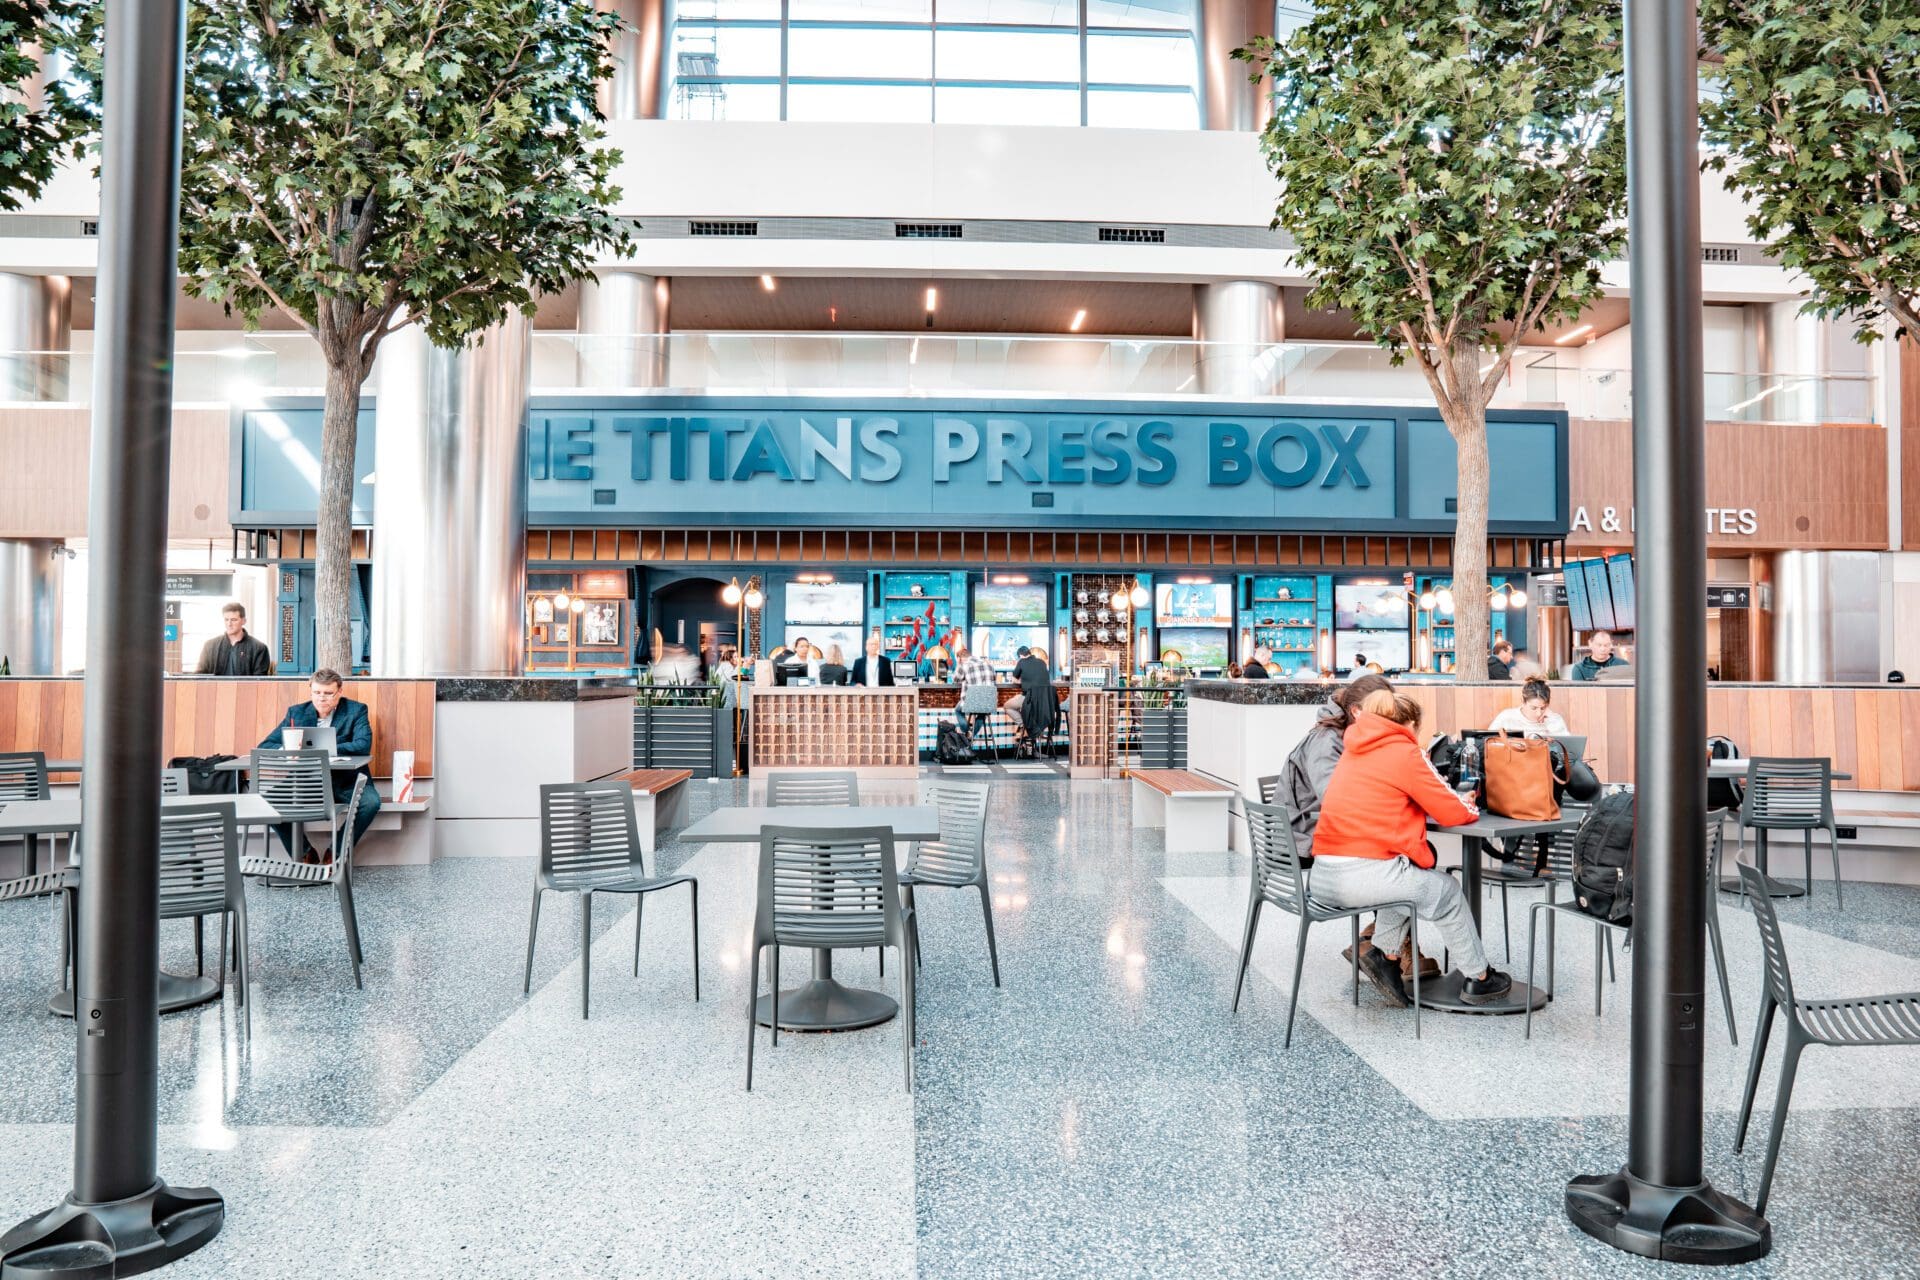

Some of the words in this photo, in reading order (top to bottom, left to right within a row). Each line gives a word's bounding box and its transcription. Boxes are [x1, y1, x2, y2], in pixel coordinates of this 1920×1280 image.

[613, 417, 902, 482] TITANS
[933, 418, 1178, 485] PRESS
[1208, 422, 1371, 488] BOX
[1570, 506, 1592, 531] A
[1600, 506, 1621, 532] &
[1705, 508, 1758, 534] TES
